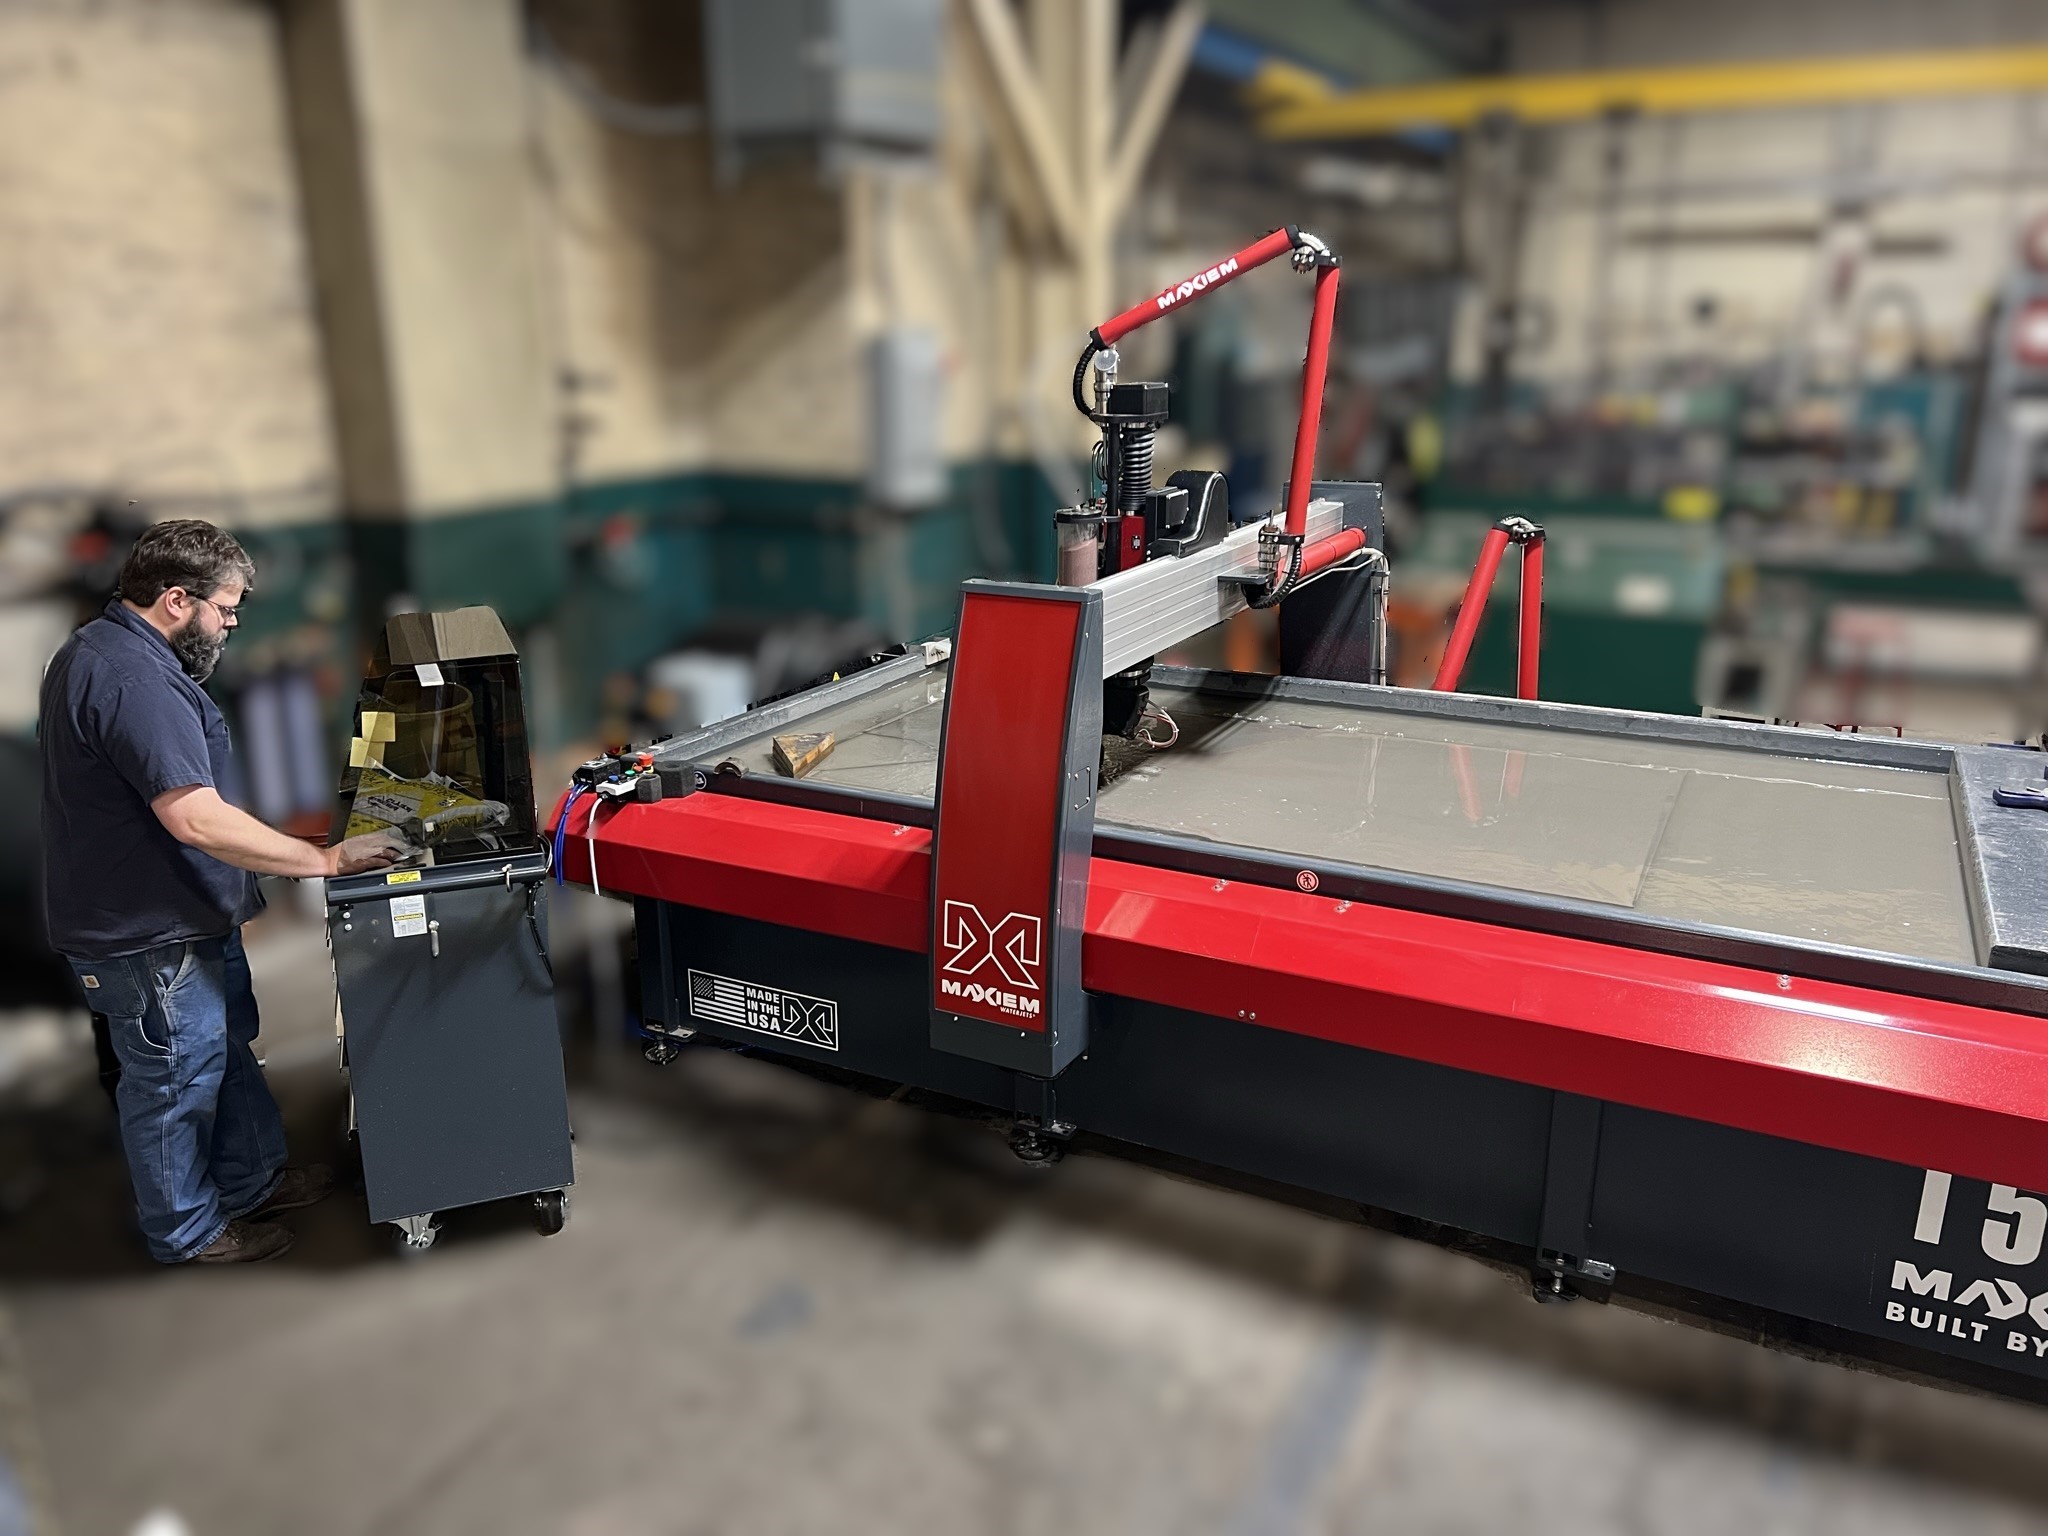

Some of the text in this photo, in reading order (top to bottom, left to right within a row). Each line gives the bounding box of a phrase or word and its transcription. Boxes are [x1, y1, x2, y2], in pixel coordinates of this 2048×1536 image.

[1157, 258, 1238, 309] MAXIEM
[746, 987, 780, 1004] MADE
[747, 1000, 780, 1016] IN THE
[941, 979, 1040, 1014] MAXIEM
[748, 1012, 781, 1032] USA
[1885, 1301, 2048, 1358] BUILT BY
